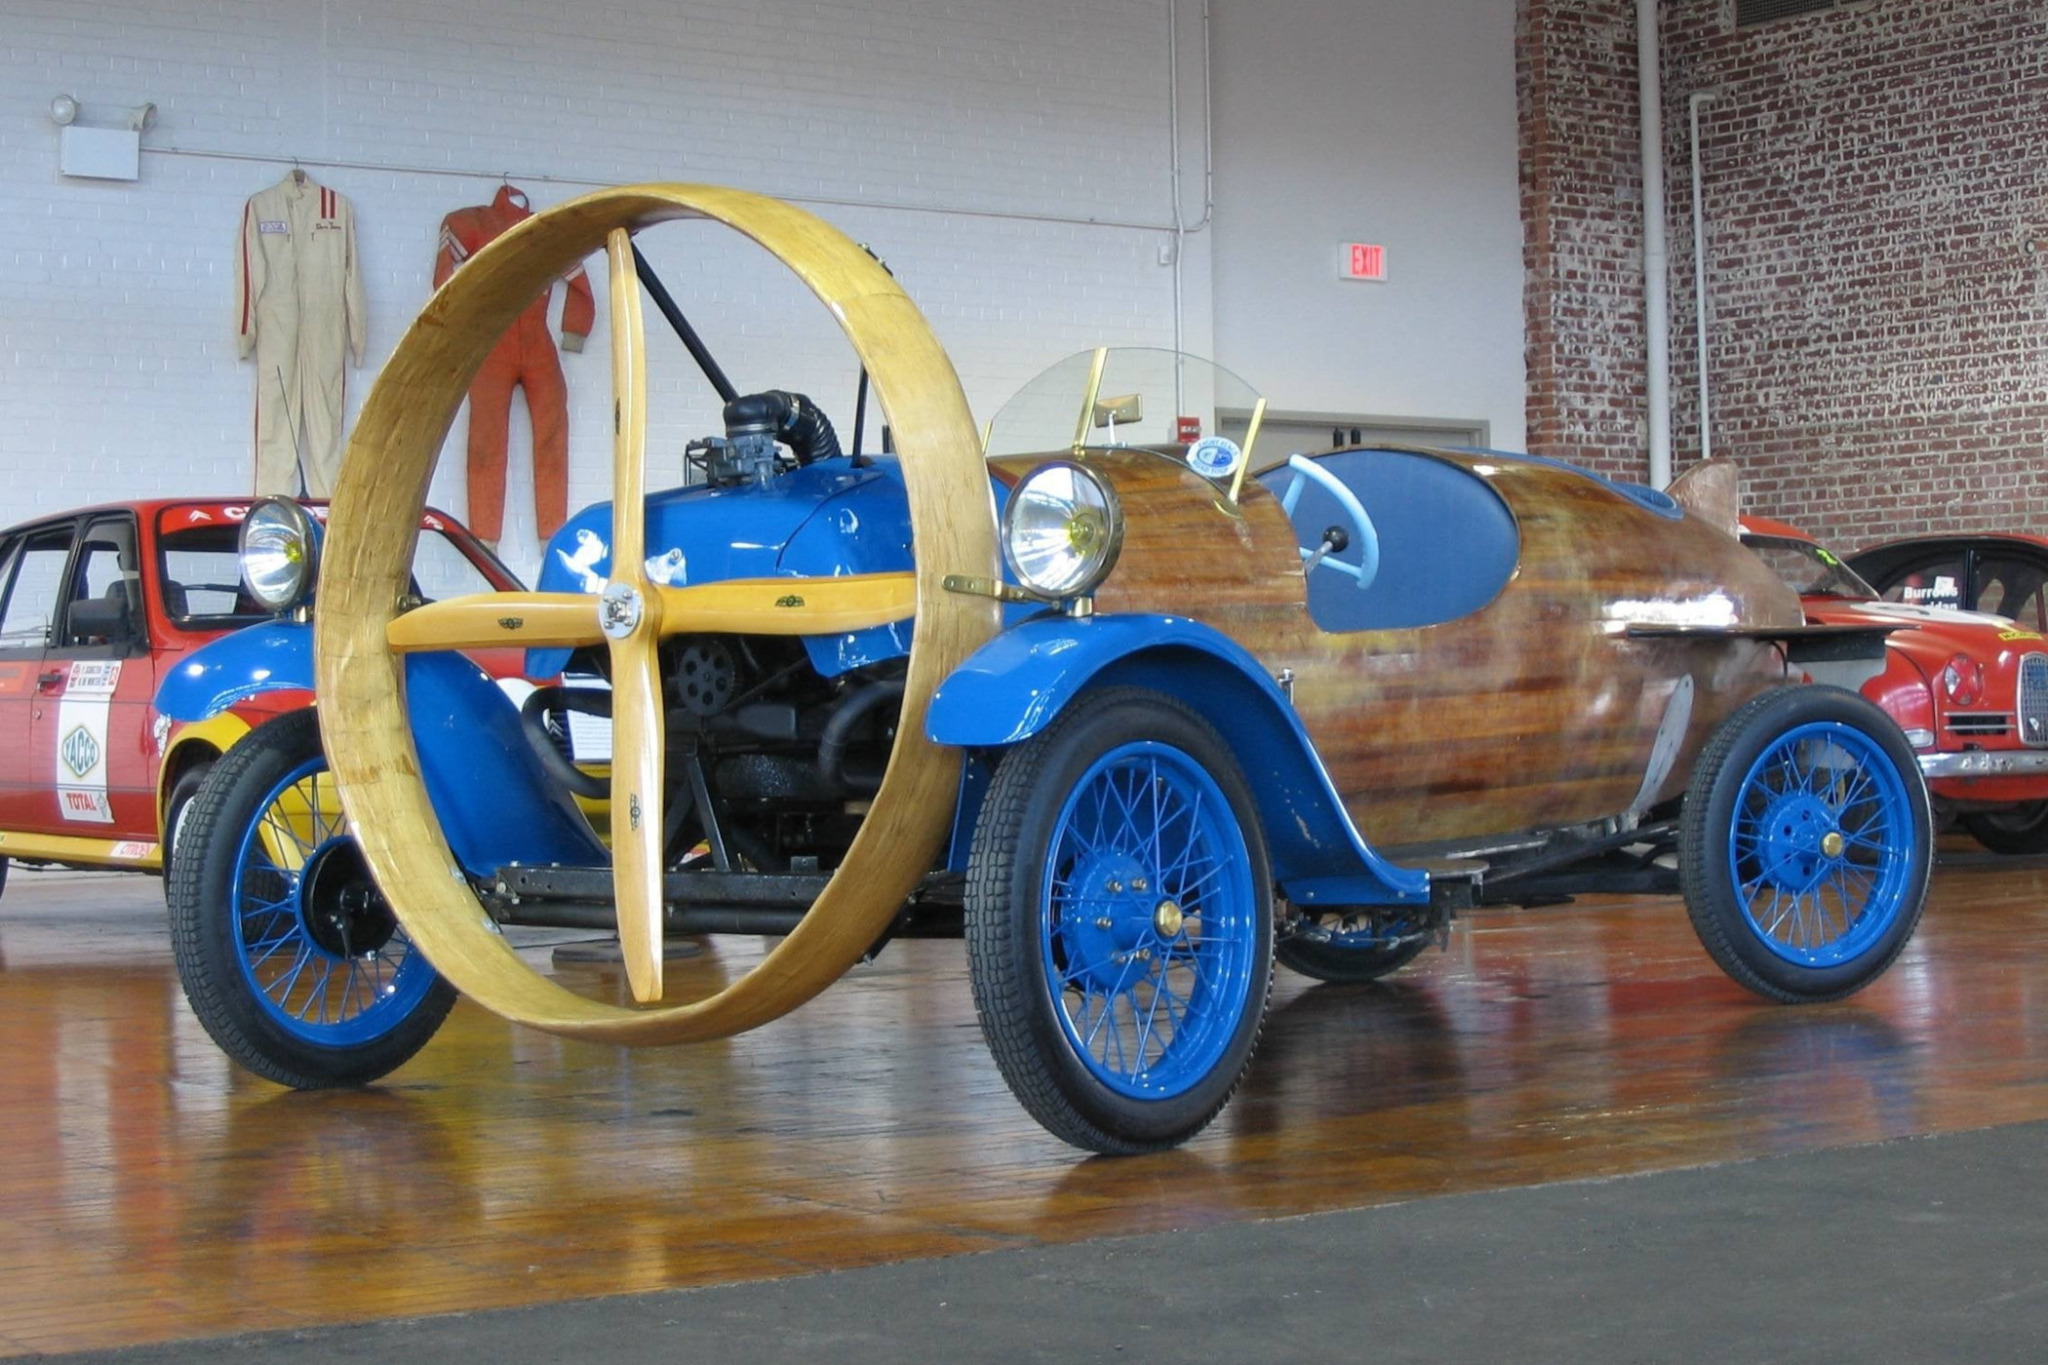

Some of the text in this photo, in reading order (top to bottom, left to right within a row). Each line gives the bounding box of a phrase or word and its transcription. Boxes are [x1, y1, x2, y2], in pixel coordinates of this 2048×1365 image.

[1352, 245, 1382, 276] EXIT
[65, 731, 96, 772] YACCO
[66, 792, 97, 811] TOTAL
